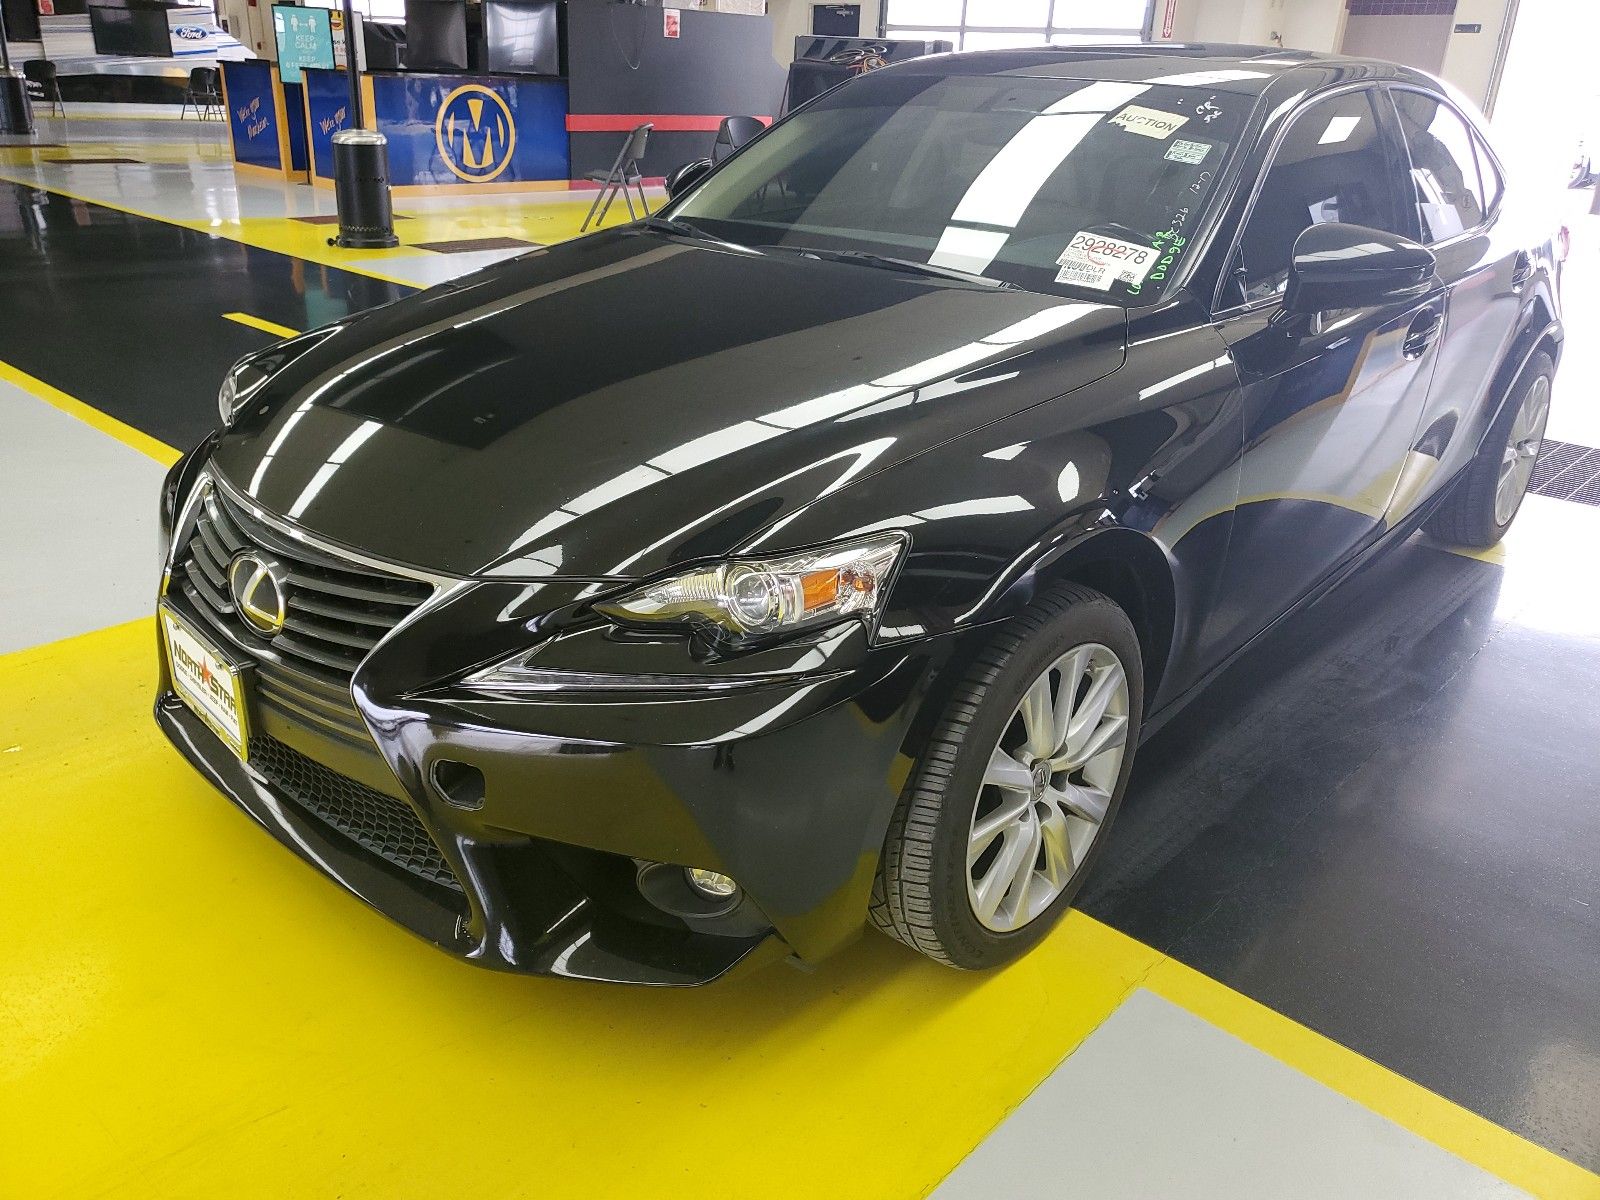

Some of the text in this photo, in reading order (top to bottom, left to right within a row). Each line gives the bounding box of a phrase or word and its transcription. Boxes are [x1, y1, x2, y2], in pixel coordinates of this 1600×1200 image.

[180, 28, 203, 39] Ford
[1115, 113, 1178, 132] AUCTION
[1070, 235, 1149, 265] 2928278
[173, 639, 205, 685] NORTH
[209, 675, 238, 716] STAR
